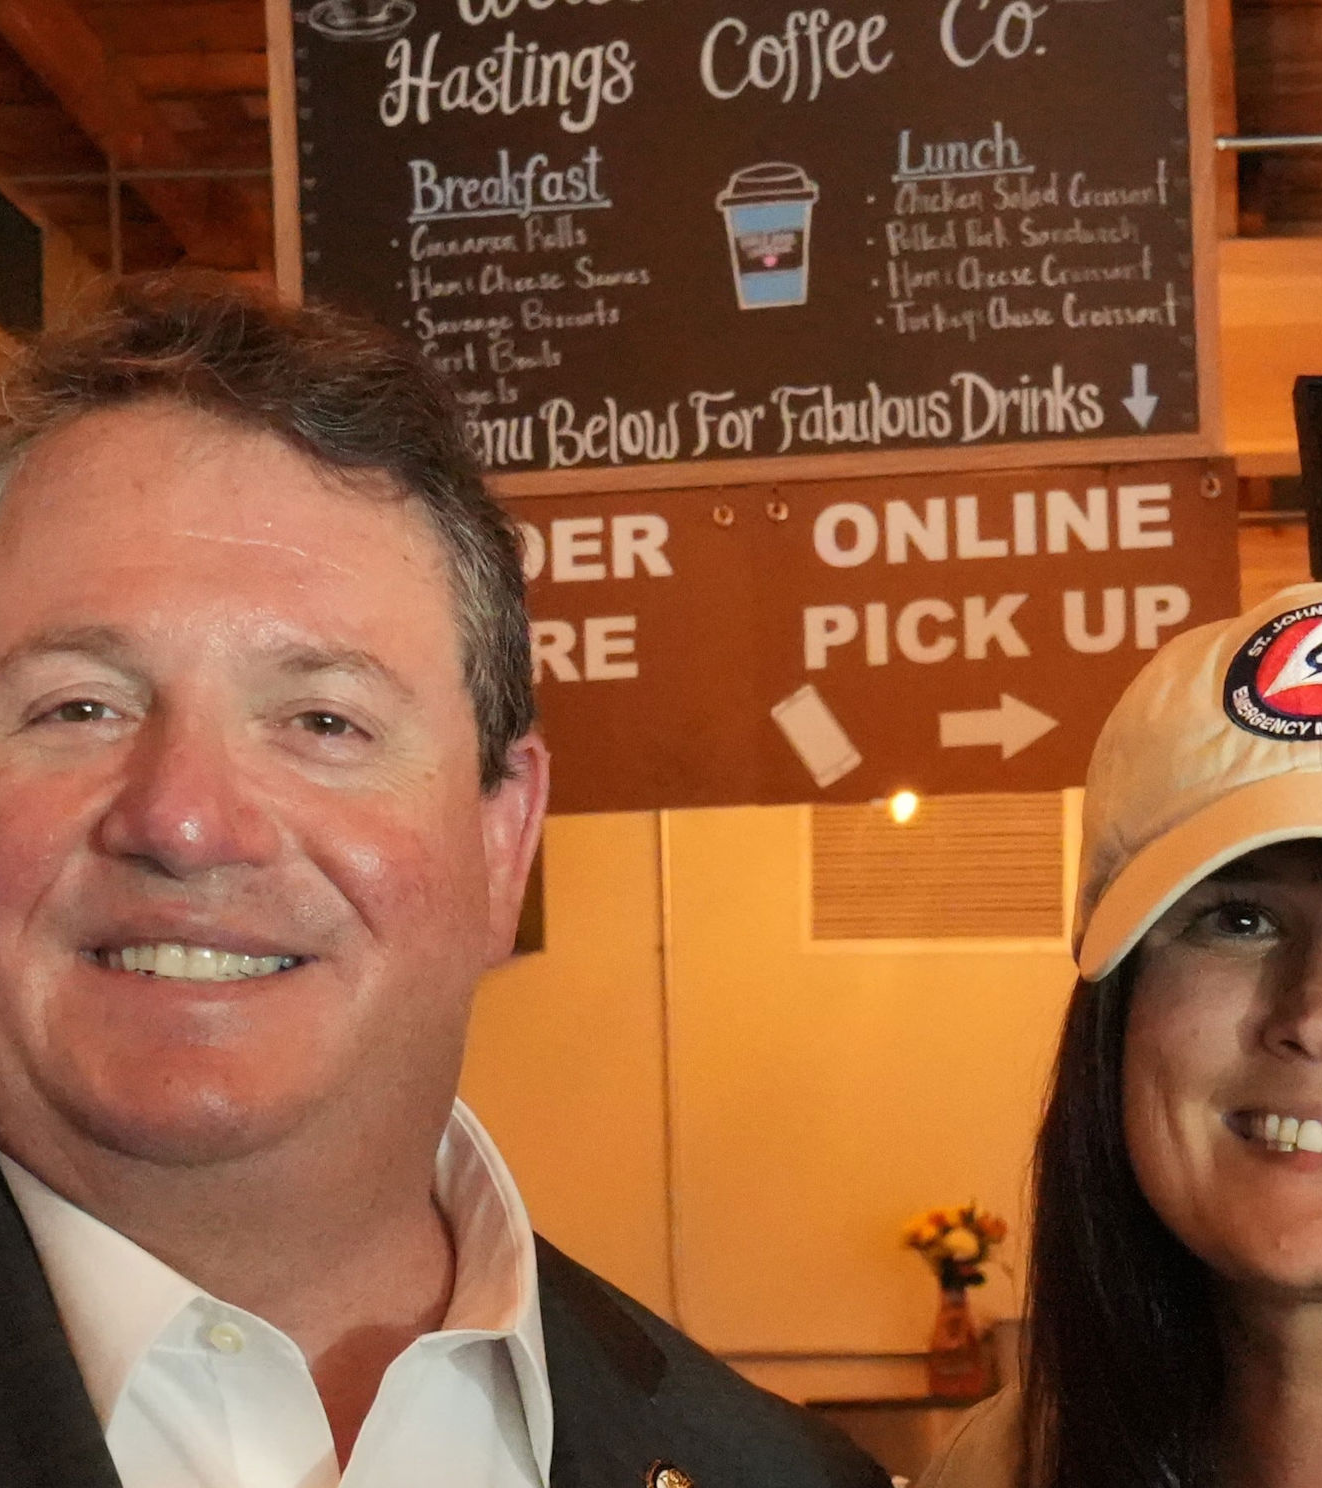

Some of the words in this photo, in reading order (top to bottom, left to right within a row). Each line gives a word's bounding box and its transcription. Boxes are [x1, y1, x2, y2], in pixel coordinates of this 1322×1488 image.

[380, 30, 636, 133] Hastings
[700, 8, 893, 103] Coffee
[940, 0, 1049, 67] Co.
[408, 146, 604, 218] Breakfast
[897, 120, 1026, 174] Lunch
[463, 415, 534, 466] enu
[539, 397, 679, 469] Below
[688, 389, 767, 457] For
[770, 381, 952, 453] Fabulous
[950, 363, 1105, 442] Drinks
[516, 514, 674, 583] DER
[812, 483, 1174, 568] ONLINE
[529, 615, 639, 684] RE
[803, 593, 1031, 670] PICK
[1063, 585, 1191, 653] UP
[1247, 635, 1272, 658] ST.
[1231, 684, 1313, 737] EMERGENCY
